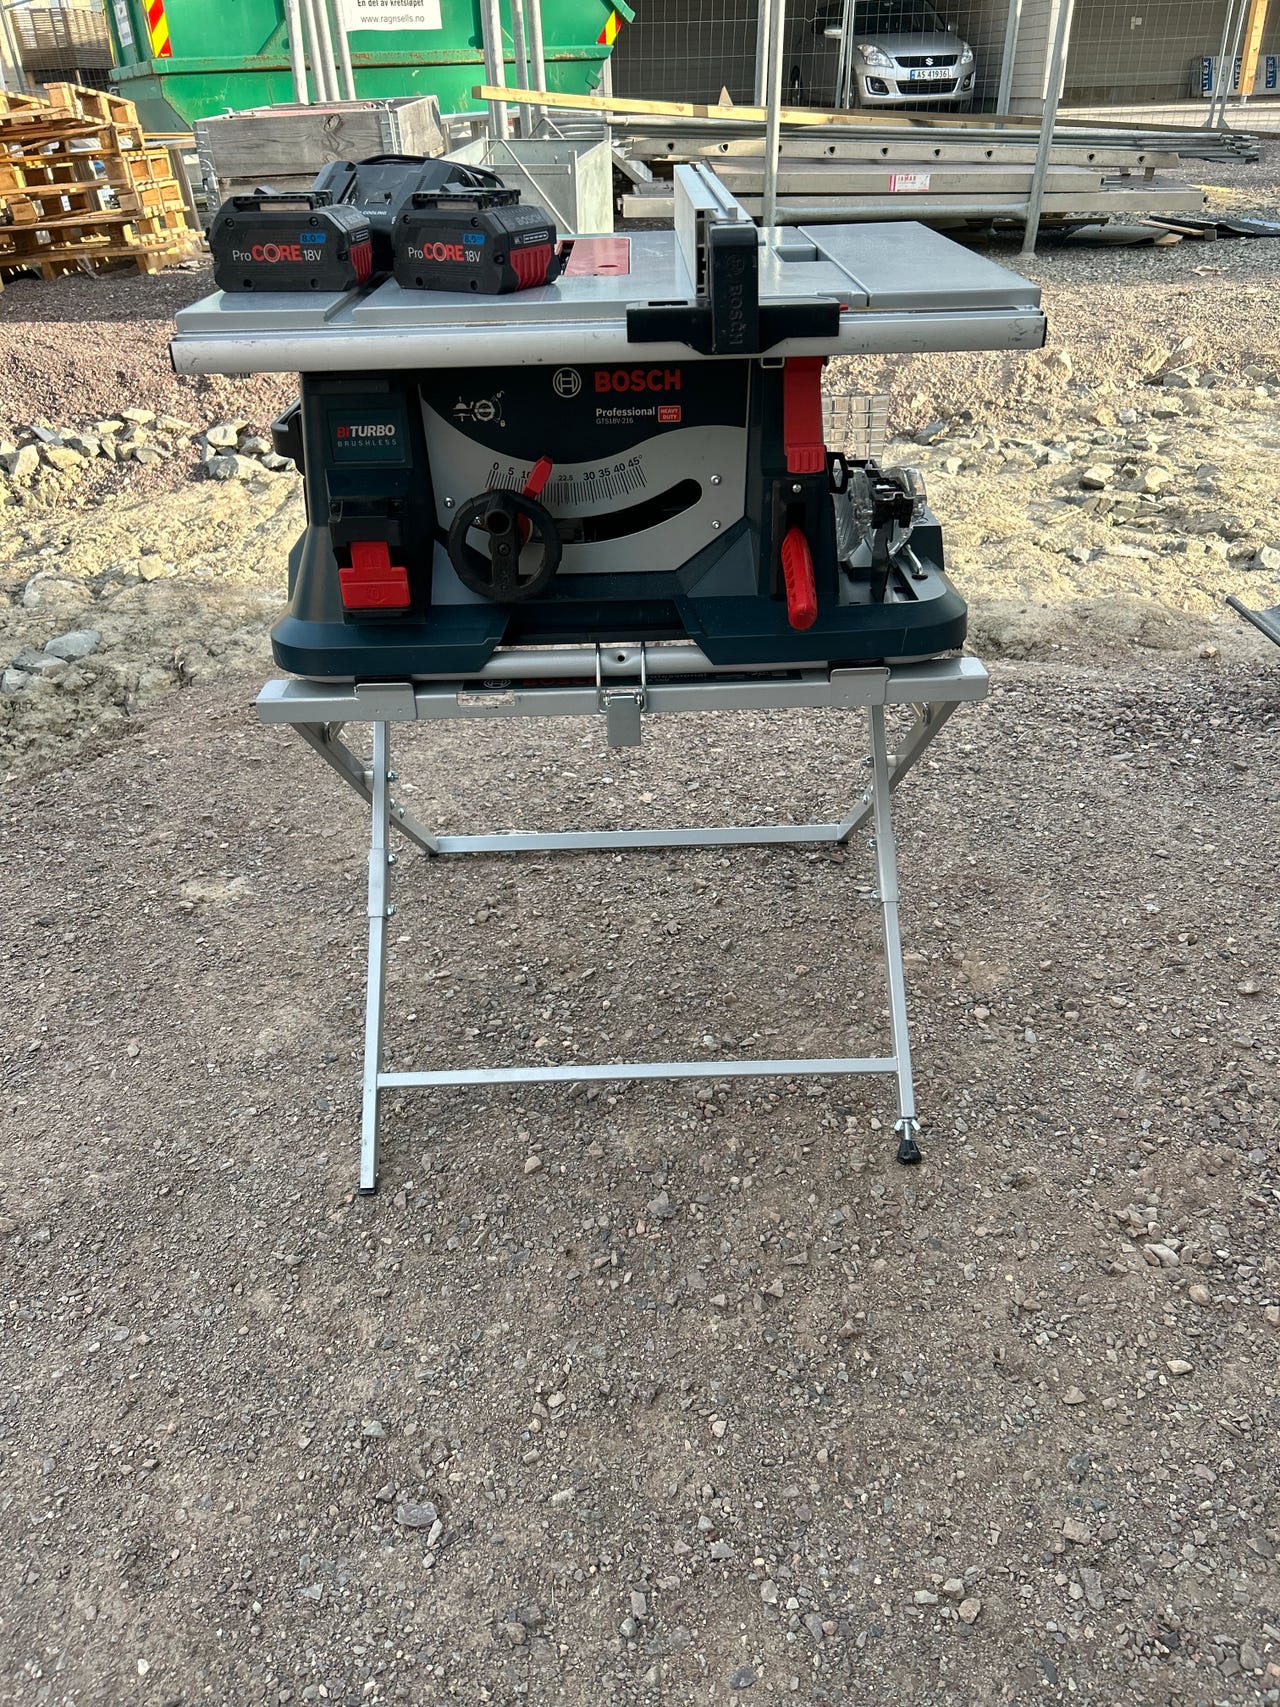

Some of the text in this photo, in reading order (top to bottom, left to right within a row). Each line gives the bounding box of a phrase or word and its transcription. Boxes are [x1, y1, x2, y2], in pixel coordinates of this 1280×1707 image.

[360, 14, 425, 24] www.ragnsells.no
[916, 70, 947, 79] AS 41936
[1202, 59, 1210, 90] LITEX
[1266, 58, 1274, 87] LITEX
[594, 369, 682, 392] BOSCH
[596, 406, 656, 417] Professional
[595, 417, 634, 425] GTS18V-216
[336, 424, 396, 438] BITURBO
[337, 439, 397, 447] BRUSHLESS
[493, 462, 499, 471] 0
[508, 467, 515, 476] 5
[583, 471, 596, 481] 30
[598, 469, 611, 478] 35
[613, 462, 626, 473] 40
